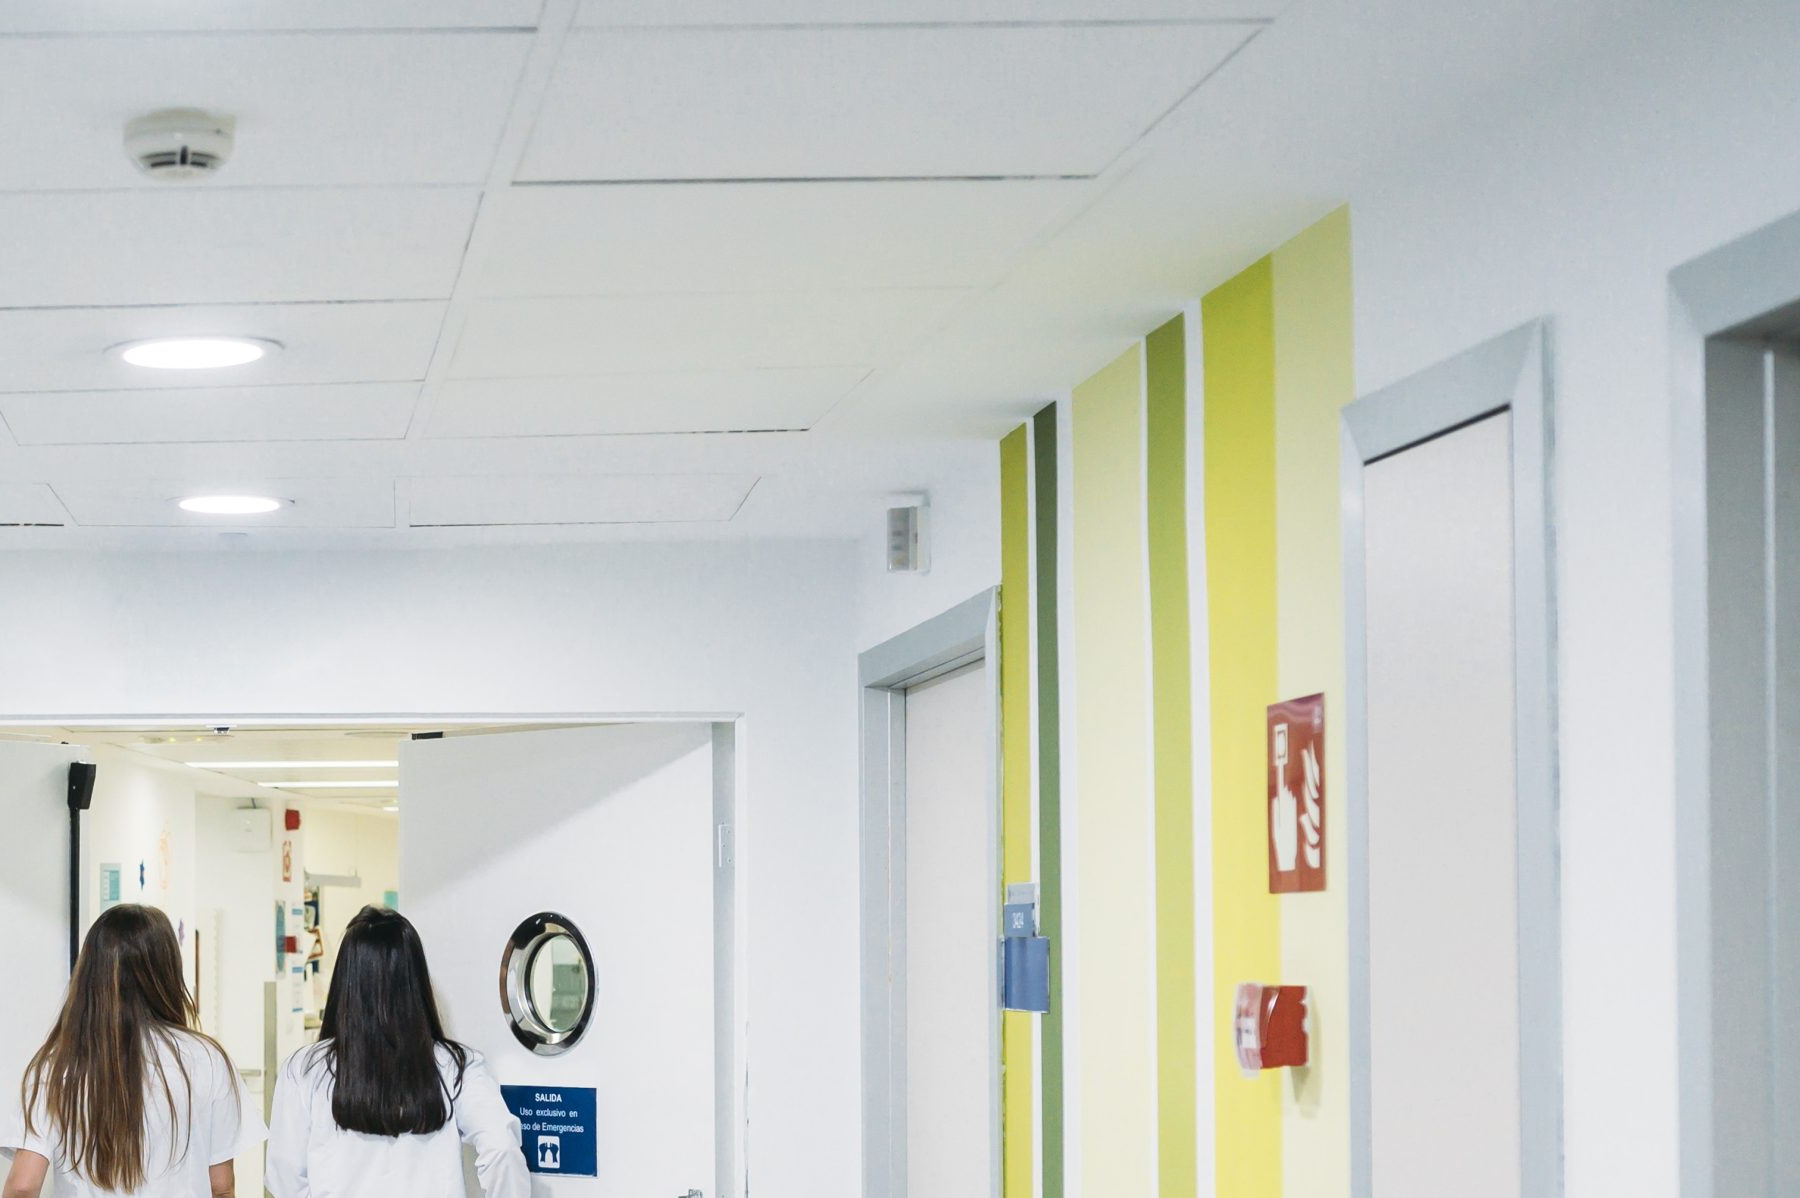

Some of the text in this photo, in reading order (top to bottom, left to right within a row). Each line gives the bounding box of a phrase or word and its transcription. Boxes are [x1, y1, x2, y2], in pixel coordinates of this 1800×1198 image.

[535, 1093, 562, 1102] SALIDA
[520, 1107, 578, 1118] Uso exclusivo en
[532, 1122, 540, 1131] de
[542, 1122, 584, 1134] Emergencias
